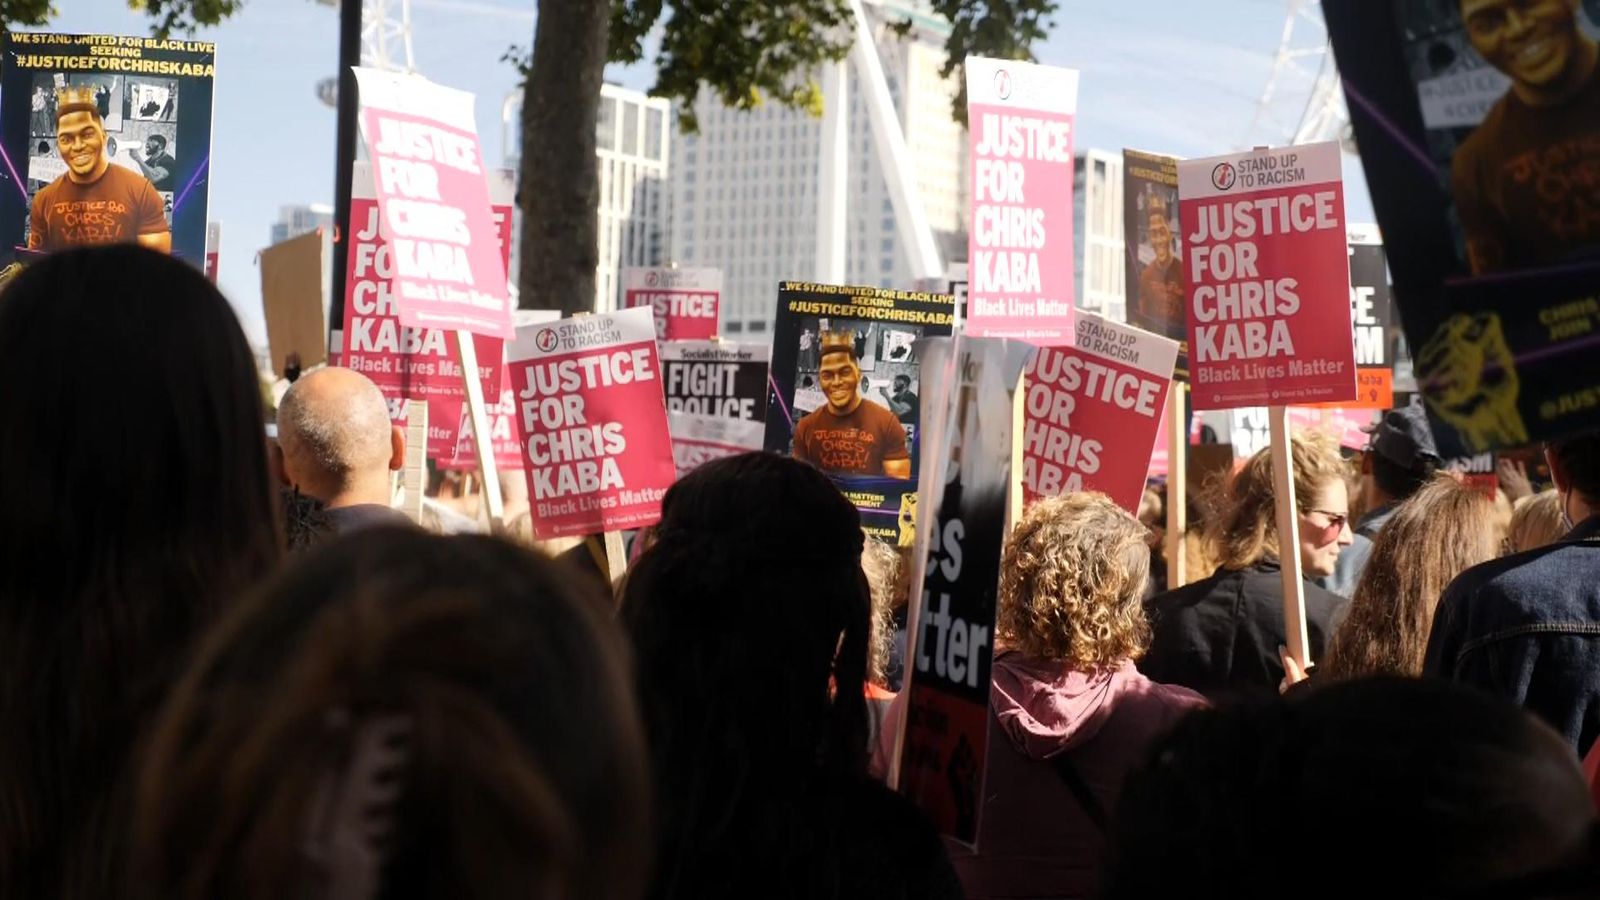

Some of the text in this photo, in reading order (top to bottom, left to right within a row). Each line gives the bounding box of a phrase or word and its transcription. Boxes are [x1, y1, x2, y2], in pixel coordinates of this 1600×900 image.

[11, 33, 214, 53] WE STAND UNITED FOR BLACK LIVE
[90, 46, 142, 58] SEEKING
[16, 55, 215, 77] #JUSTICEFORCHRISKABA
[375, 116, 482, 175] JUSTICE
[976, 112, 1071, 164] JUSTICE
[378, 155, 442, 201] FOR
[975, 158, 1026, 204] FOR
[1238, 154, 1298, 174] STAND UP
[1238, 168, 1305, 189] TO RACISM
[386, 197, 472, 247] CHRIS
[975, 204, 1046, 249] CHRIS
[1188, 191, 1339, 244] JUSTICE
[355, 243, 394, 280] FO
[392, 238, 475, 286] KABA
[974, 251, 1042, 294] KABA
[1190, 241, 1260, 283] FOR
[786, 281, 802, 292] WE
[804, 282, 838, 294] STAND
[838, 286, 875, 297] UNITED
[875, 288, 897, 299] FOR
[897, 290, 931, 302] BLACK
[851, 296, 895, 308] SEEKING
[974, 298, 1007, 316] Black
[1008, 298, 1036, 317] Lives
[1037, 298, 1069, 316] Matter
[1192, 277, 1301, 323] CHRIS
[559, 319, 614, 338] STAND UP
[788, 300, 956, 326] #JUSTICEFORCHRISKABA
[350, 317, 448, 357] KABA
[561, 330, 623, 350] TO RACISM
[1075, 333, 1091, 348] TO
[1093, 341, 1140, 364] RACISM
[1078, 319, 1118, 342] STAND
[1119, 334, 1137, 348] UP
[1194, 319, 1296, 363] KABA
[350, 355, 494, 380] Black Lives Maer
[519, 348, 655, 400] JUSTICE
[681, 349, 718, 360] Socialist
[1198, 358, 1344, 384] Black Lives Matter
[667, 362, 740, 397] FIGHT
[1024, 347, 1162, 418] JUSTICE
[521, 394, 587, 433] FOR
[1024, 377, 1076, 428] OR
[428, 426, 452, 440] tter
[528, 421, 627, 466] CHRIS
[1024, 418, 1104, 475] HRIS
[531, 457, 625, 500] KABA
[1023, 456, 1084, 498] ABA
[537, 487, 668, 518] Black Lives Matter
[850, 492, 885, 502] MATTERS
[916, 589, 989, 689] tter
